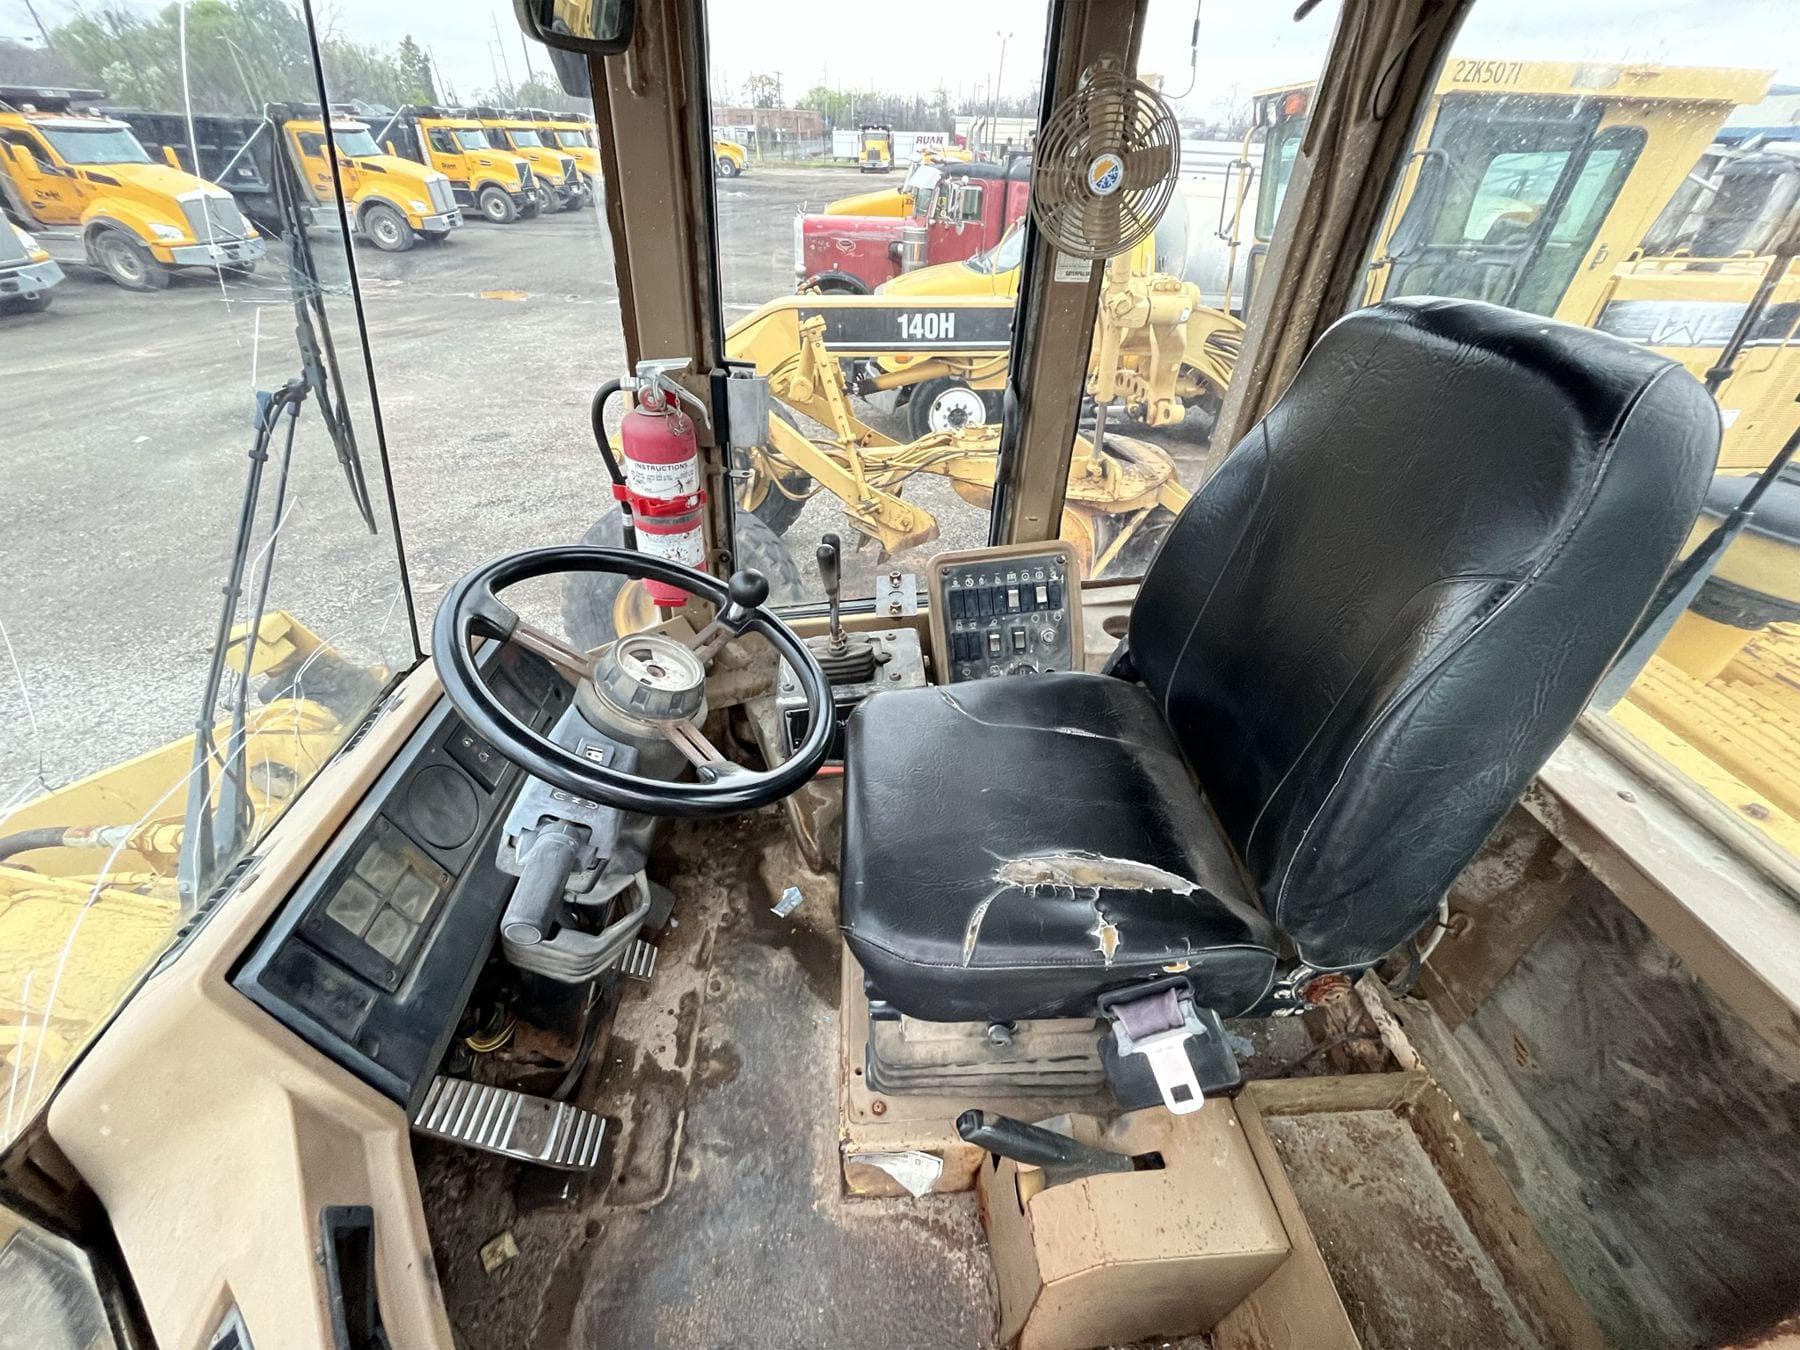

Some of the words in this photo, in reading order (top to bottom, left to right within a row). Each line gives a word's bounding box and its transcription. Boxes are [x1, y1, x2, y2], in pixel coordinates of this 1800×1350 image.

[1453, 60, 1523, 84] 2ZK5071
[916, 135, 944, 145] RUAN
[897, 312, 955, 339] 140H
[635, 463, 688, 472] INSTRUCTIONS
